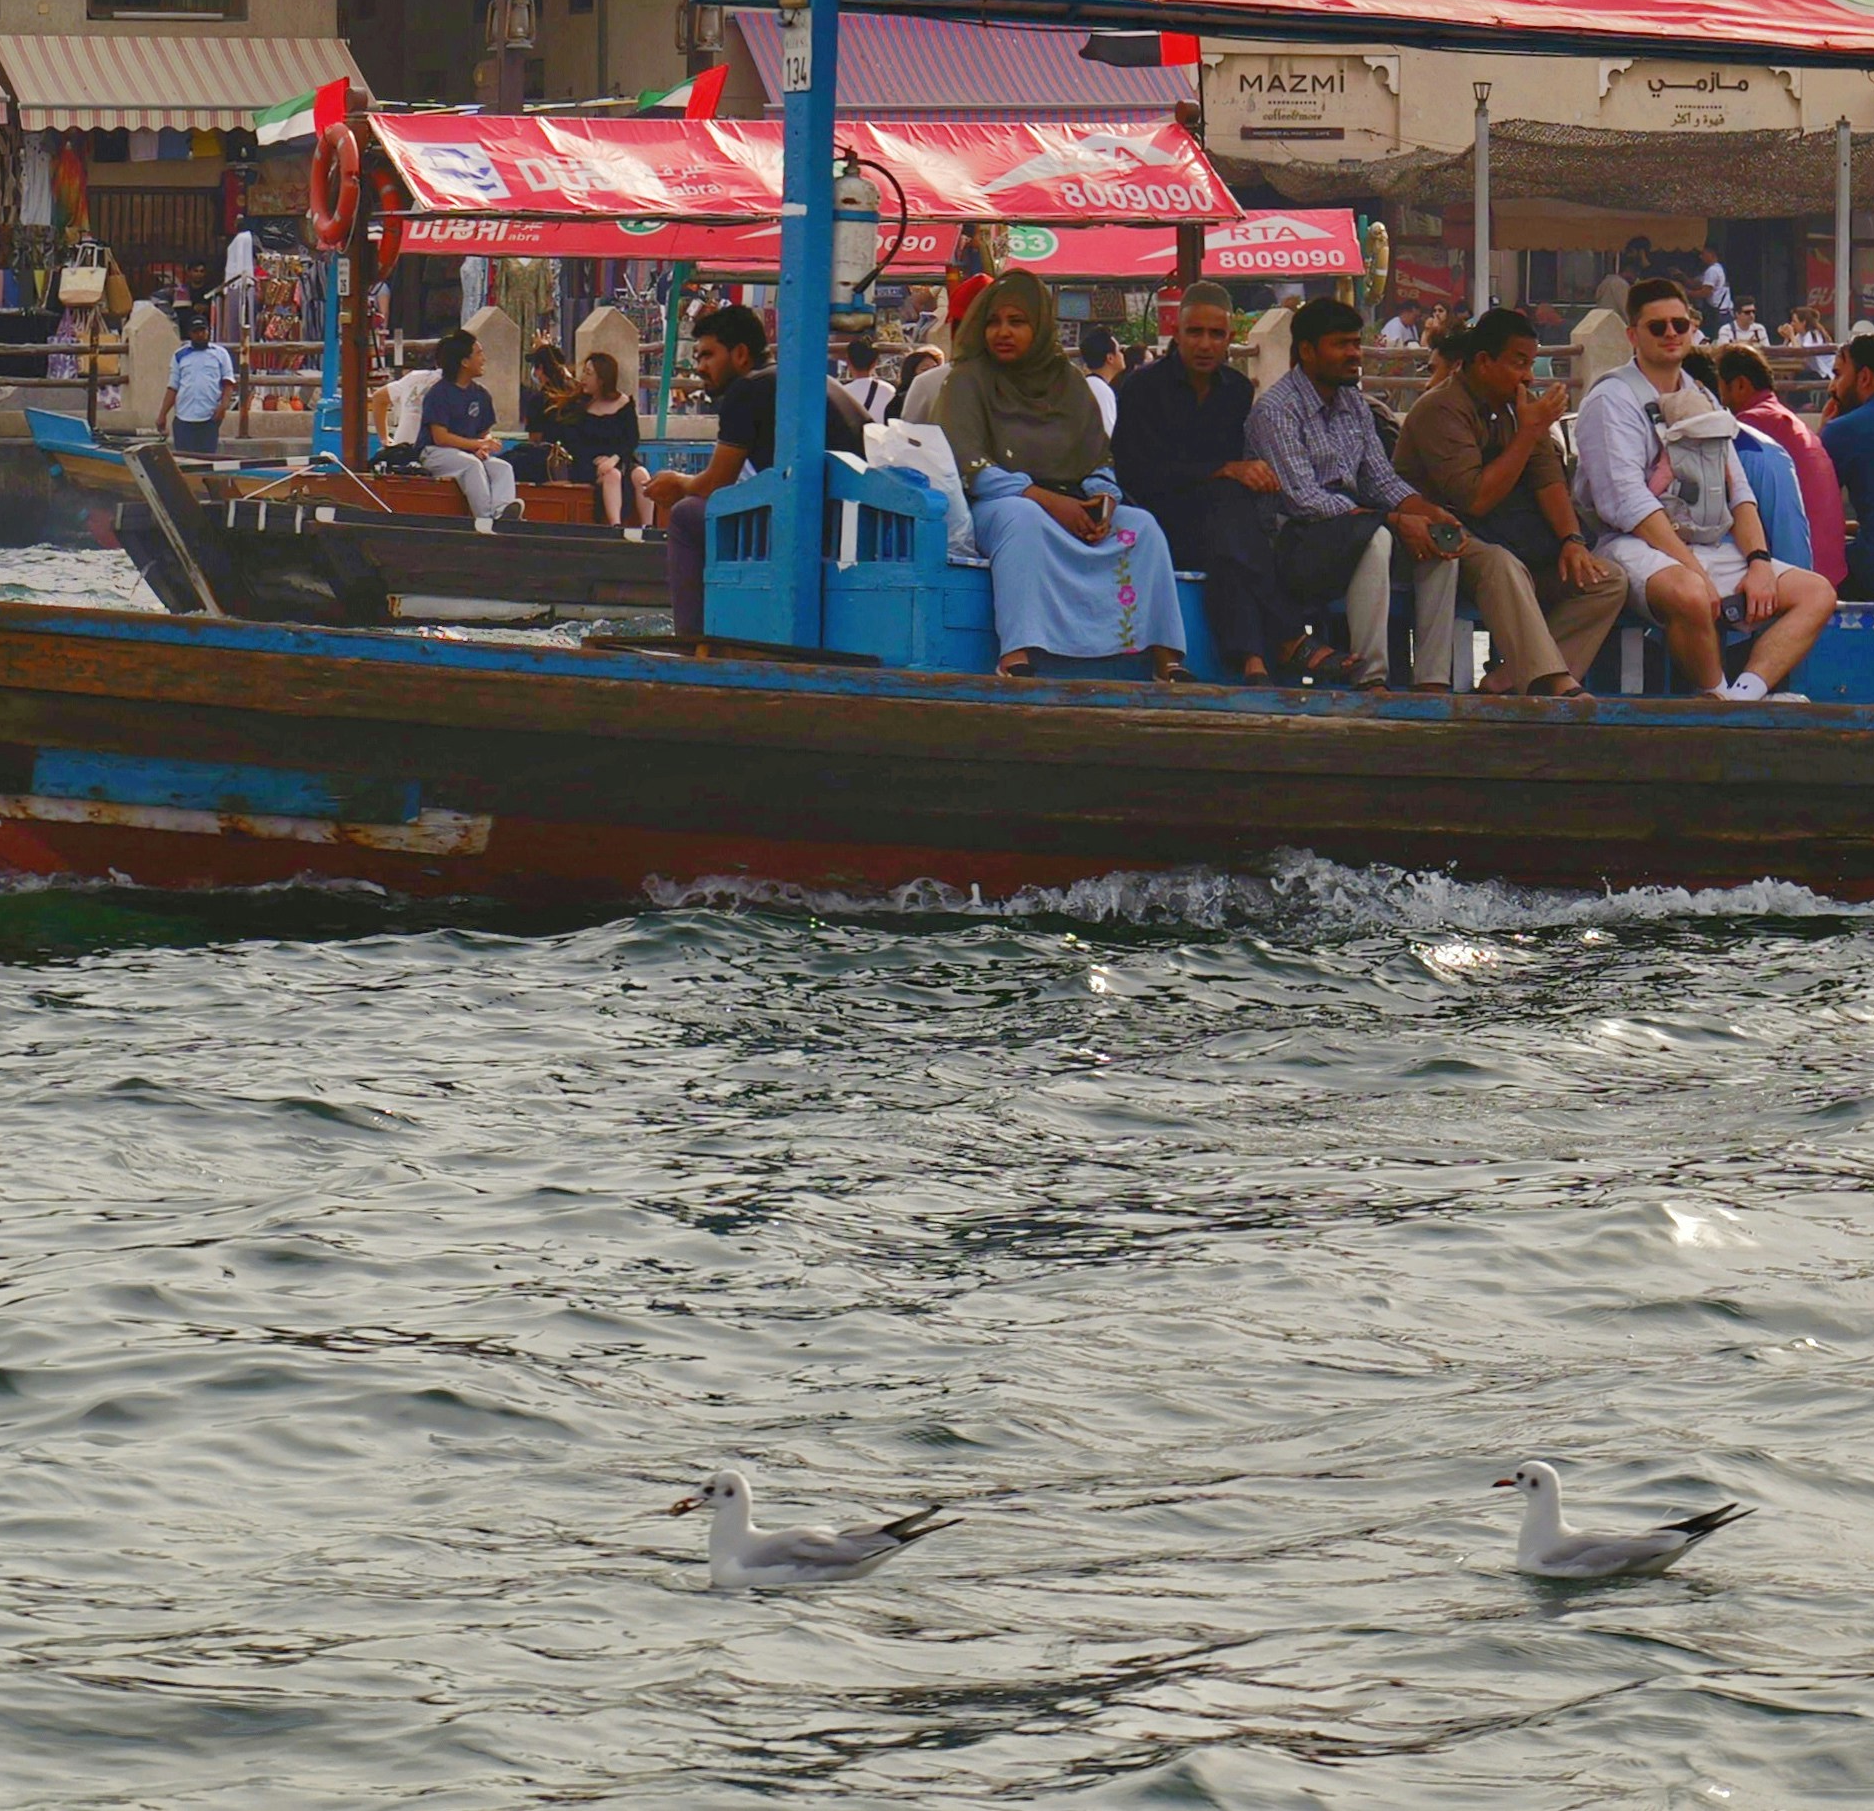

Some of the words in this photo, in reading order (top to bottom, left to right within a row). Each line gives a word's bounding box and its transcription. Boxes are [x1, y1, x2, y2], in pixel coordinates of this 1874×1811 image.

[786, 56, 807, 87] 134
[1648, 72, 1749, 98] مازمي
[672, 181, 723, 197] abra
[1060, 182, 1214, 212] 8009090
[408, 219, 511, 243] DUBAI
[507, 231, 540, 242] abra
[1229, 226, 1303, 241] RTA
[1008, 234, 1048, 252] 63
[1218, 249, 1346, 269] 8009090
